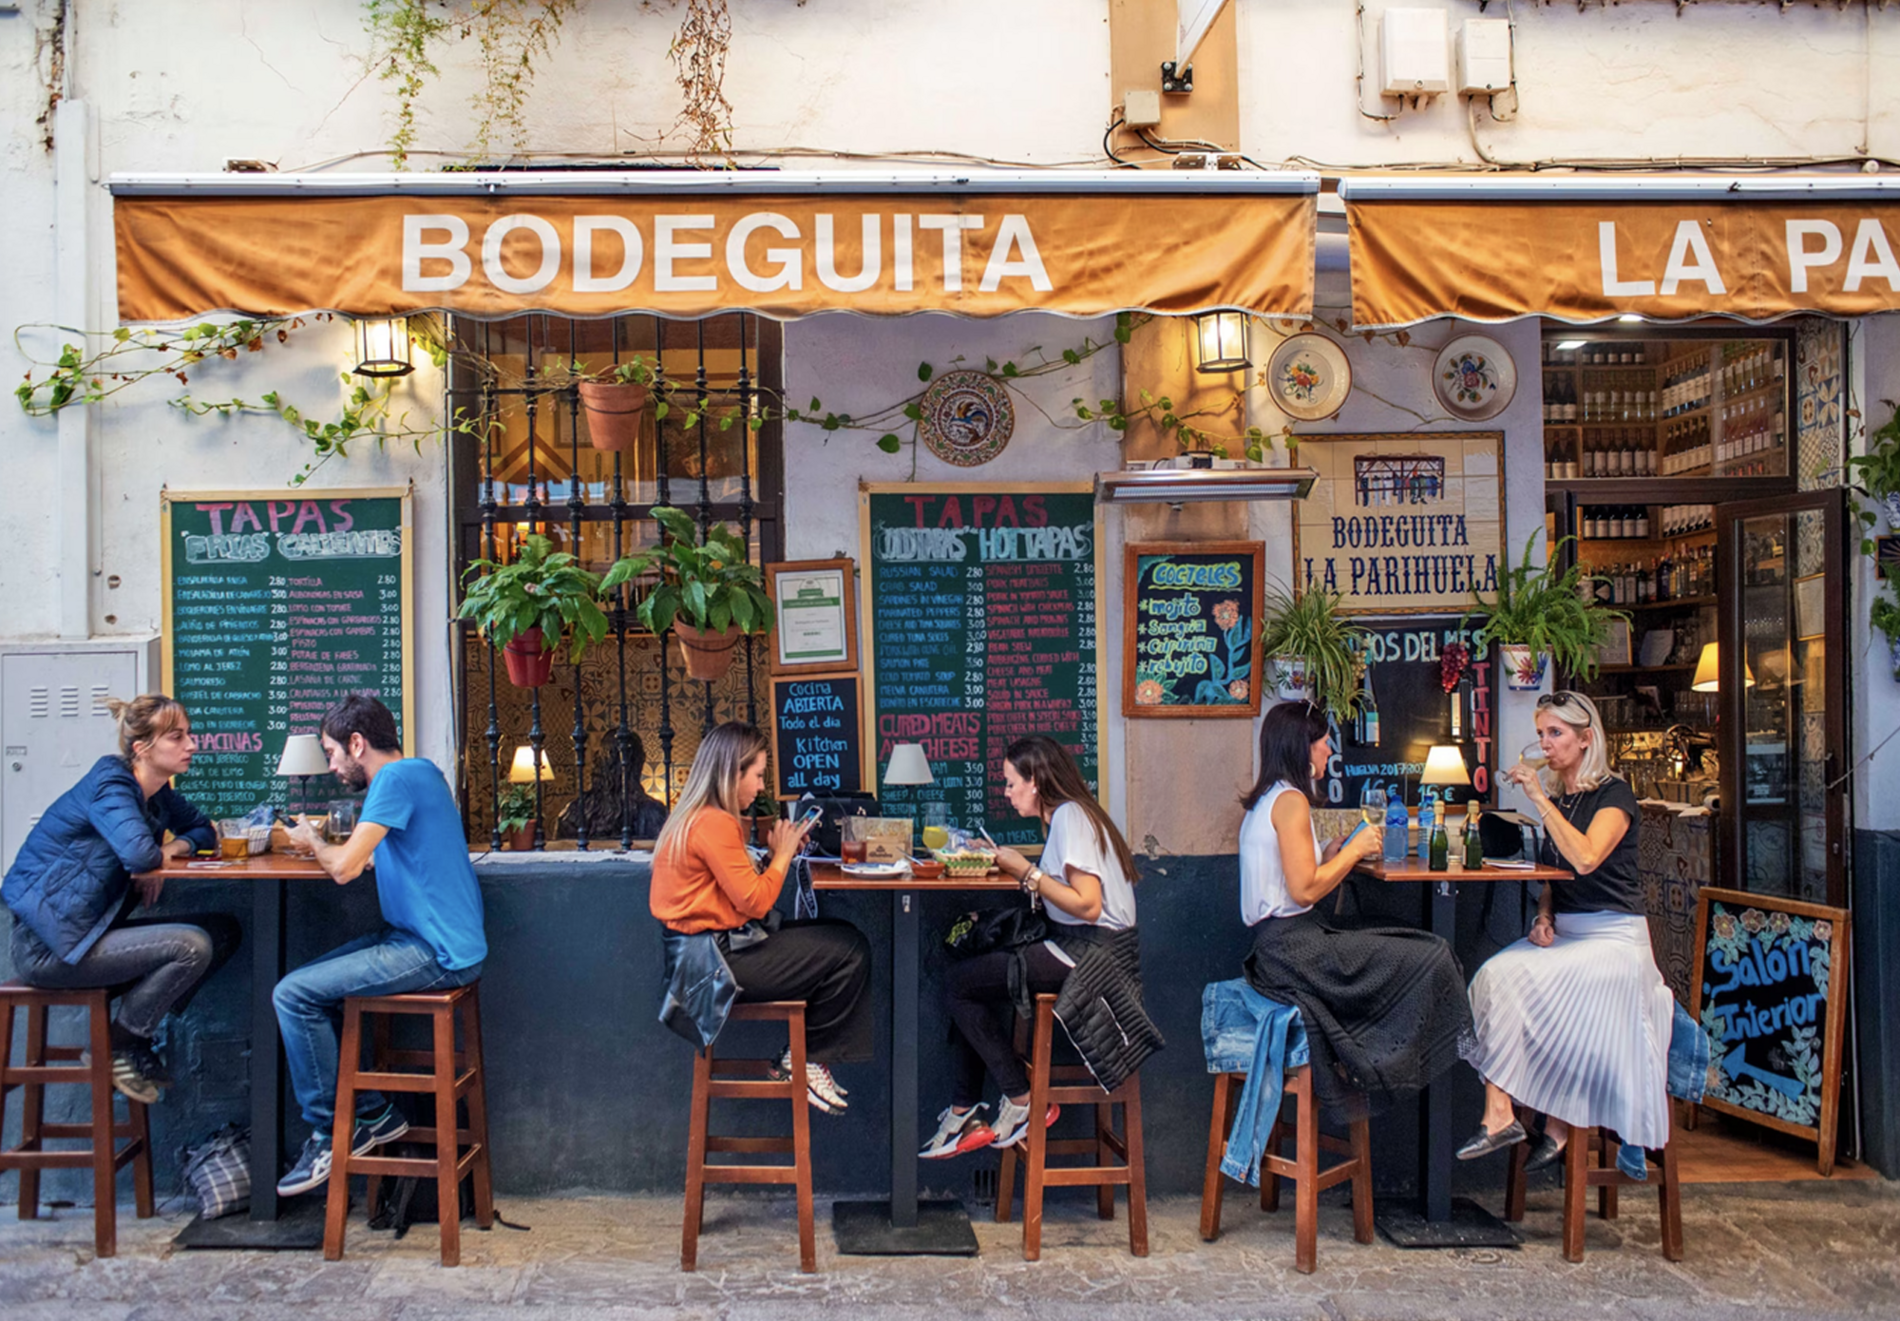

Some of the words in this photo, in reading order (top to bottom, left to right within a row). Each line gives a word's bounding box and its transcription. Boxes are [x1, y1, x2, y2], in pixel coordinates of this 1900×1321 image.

[402, 213, 1054, 294] BODEGUITA
[1599, 219, 1727, 297] LA
[1785, 218, 1900, 293] PA
[195, 499, 354, 535] TAPAS
[904, 496, 1048, 529] TAPAS
[1331, 514, 1469, 549] BODEGUITA
[880, 567, 921, 578] RUSSIAN
[929, 566, 959, 578] SALAD
[1304, 557, 1340, 596] LA
[1349, 554, 1499, 596] PARIHUELA
[377, 575, 396, 584] 2.80
[909, 581, 937, 591] SALAD
[379, 590, 397, 600] 3.00
[1149, 592, 1201, 621] mojito
[382, 639, 401, 648] 2.80
[1404, 632, 1440, 662] DEL
[383, 651, 401, 659] 2.80
[270, 661, 287, 671] 2.80
[382, 663, 400, 672] 2.80
[1148, 652, 1207, 678] rebujito
[270, 676, 287, 685] 2.80
[382, 675, 400, 684] 2.80
[935, 671, 956, 681] SOUP
[268, 690, 287, 699] 3.50
[789, 683, 832, 697] Cocina
[965, 684, 984, 695] 3.00
[268, 705, 287, 714] 3.00
[783, 696, 844, 714] ABIERTA
[965, 697, 984, 708] 3.00
[267, 720, 286, 730] 3.00
[779, 716, 806, 730] Todo
[879, 713, 931, 737] CURED
[931, 712, 981, 736] MEATS
[1472, 662, 1491, 793] TINTO
[191, 732, 263, 752] HACINAS
[796, 736, 848, 753] Kitchen
[920, 738, 979, 760] CHEESE
[793, 753, 840, 769] OPEN
[1345, 764, 1379, 777] HUELVA
[813, 771, 841, 790] day
[1007, 829, 1038, 843] MEATS
[1711, 937, 1811, 999] Salón
[1714, 992, 1823, 1043] Interior
